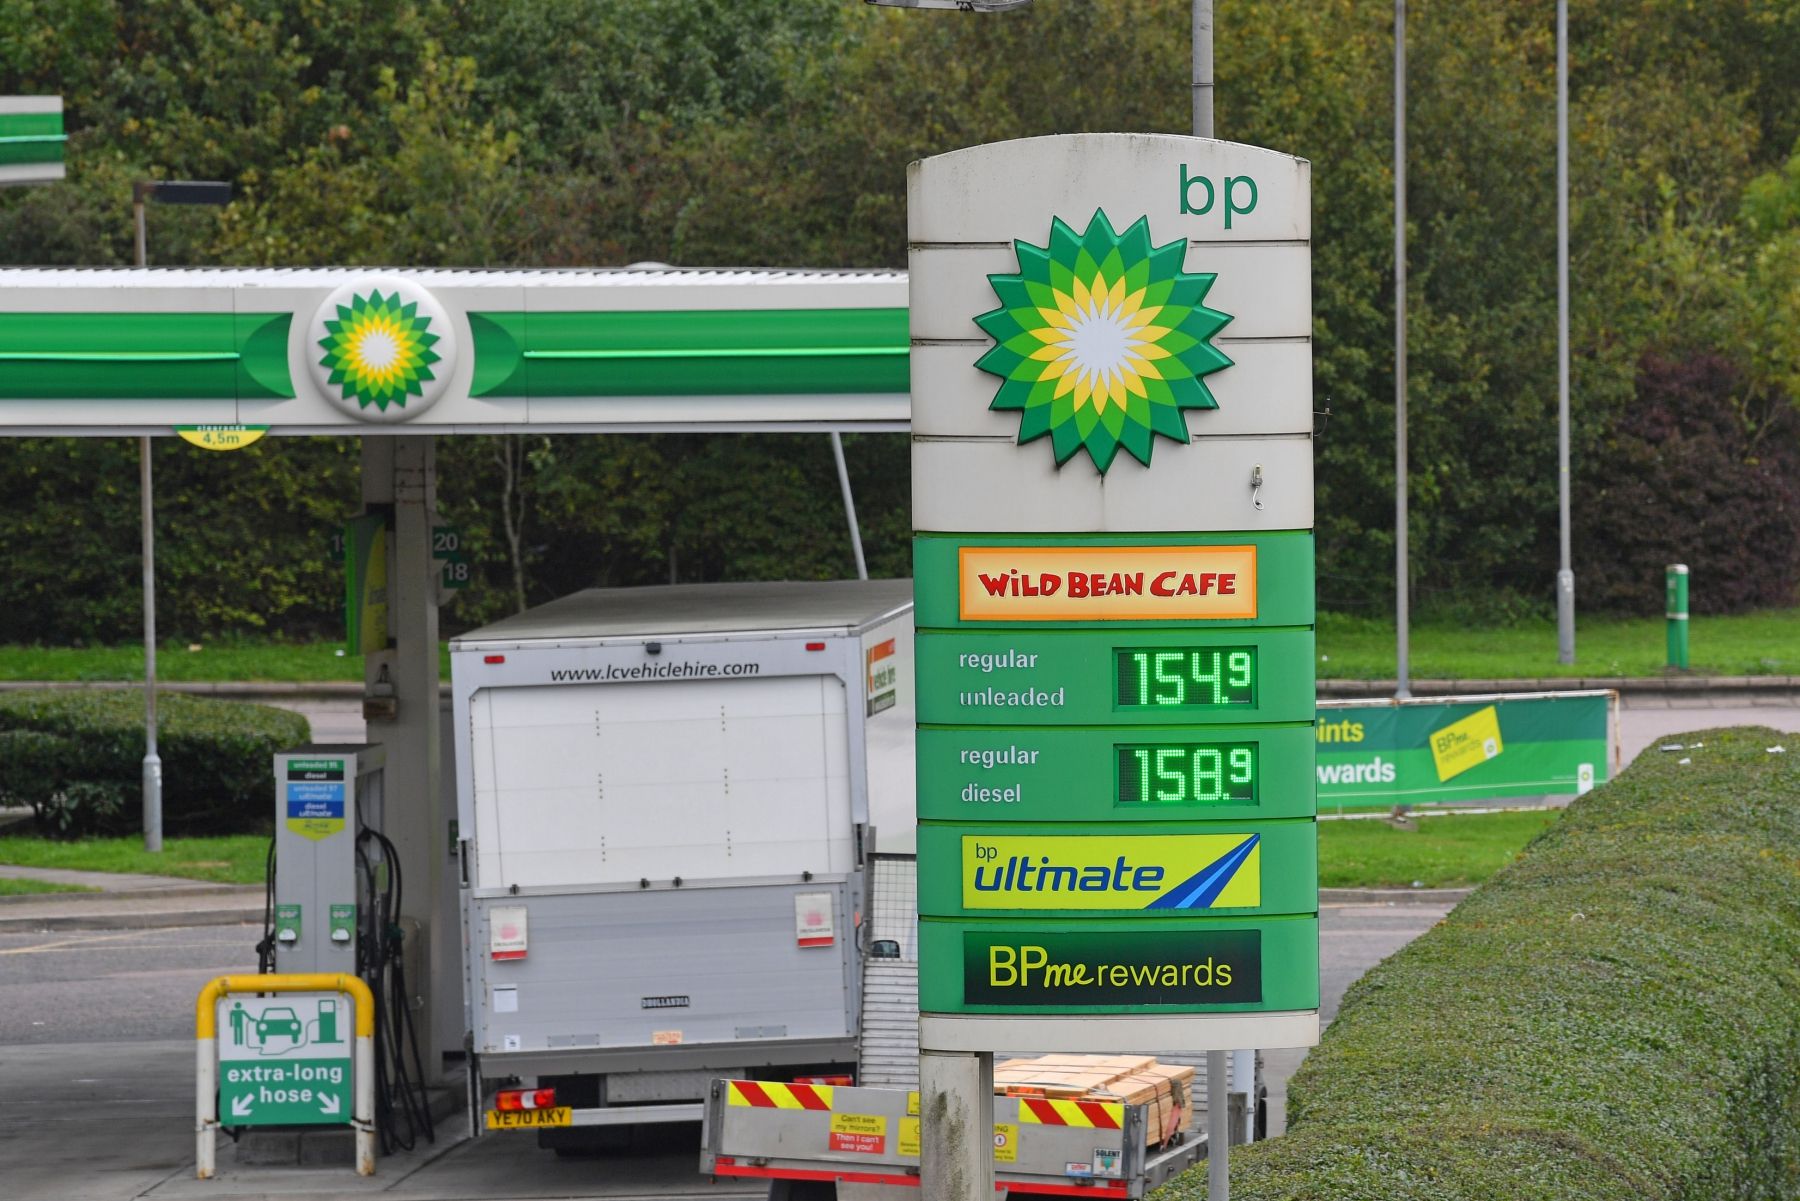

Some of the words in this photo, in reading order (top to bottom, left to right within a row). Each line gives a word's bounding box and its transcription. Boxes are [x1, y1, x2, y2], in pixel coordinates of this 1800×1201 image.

[1179, 164, 1258, 229] bp
[434, 532, 458, 551] 20
[445, 563, 468, 581] 18
[1067, 572, 1144, 600] BEAN
[1150, 571, 1237, 598] CAFE
[959, 650, 1038, 671] regular
[551, 660, 760, 683] www.lcvehiclehire.com
[959, 687, 1065, 708] unleaded
[1316, 718, 1365, 743] ints
[960, 746, 1039, 768] regular
[1316, 756, 1396, 785] wards
[960, 783, 1022, 804] diesel
[975, 842, 998, 863] bp
[974, 855, 1165, 892] ultimate
[1096, 957, 1233, 988] rewards
[227, 1063, 343, 1086] extra-long
[259, 1085, 313, 1104] hose
[494, 1111, 533, 1125] YE70
[537, 1108, 566, 1123] AKY
[835, 1133, 855, 1142] Then
[1095, 1150, 1121, 1158] SOLENT
